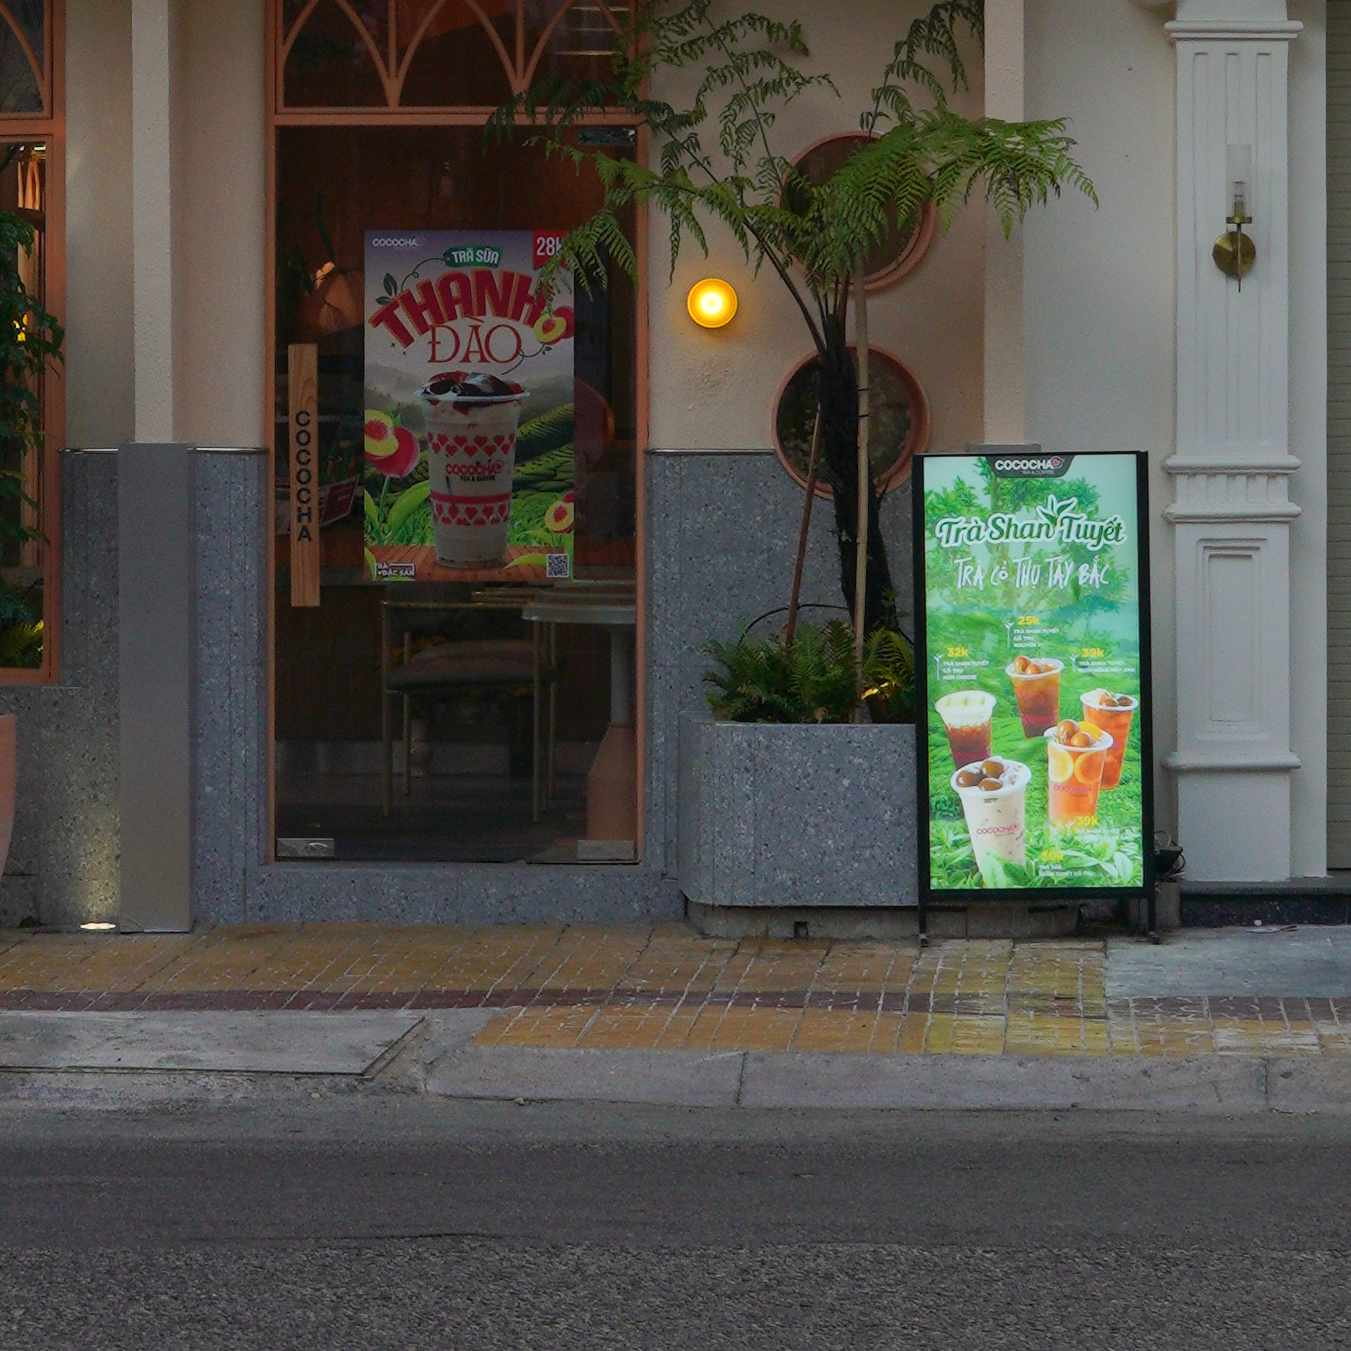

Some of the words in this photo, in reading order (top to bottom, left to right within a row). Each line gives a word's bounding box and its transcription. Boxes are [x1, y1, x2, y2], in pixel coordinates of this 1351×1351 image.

[372, 238, 418, 247] COCOCHA
[451, 248, 474, 264] TRÀ
[475, 246, 499, 265] SỮA
[368, 269, 546, 349] THANH
[427, 315, 523, 364] ĐÀO
[994, 459, 1054, 471] COCOCHA
[295, 410, 312, 542] COCOCHA
[937, 517, 983, 546] Trà
[987, 514, 1053, 543] Shan
[1060, 515, 1126, 550] Tuyết
[1018, 616, 1041, 626] 25k
[947, 647, 969, 658] 32k
